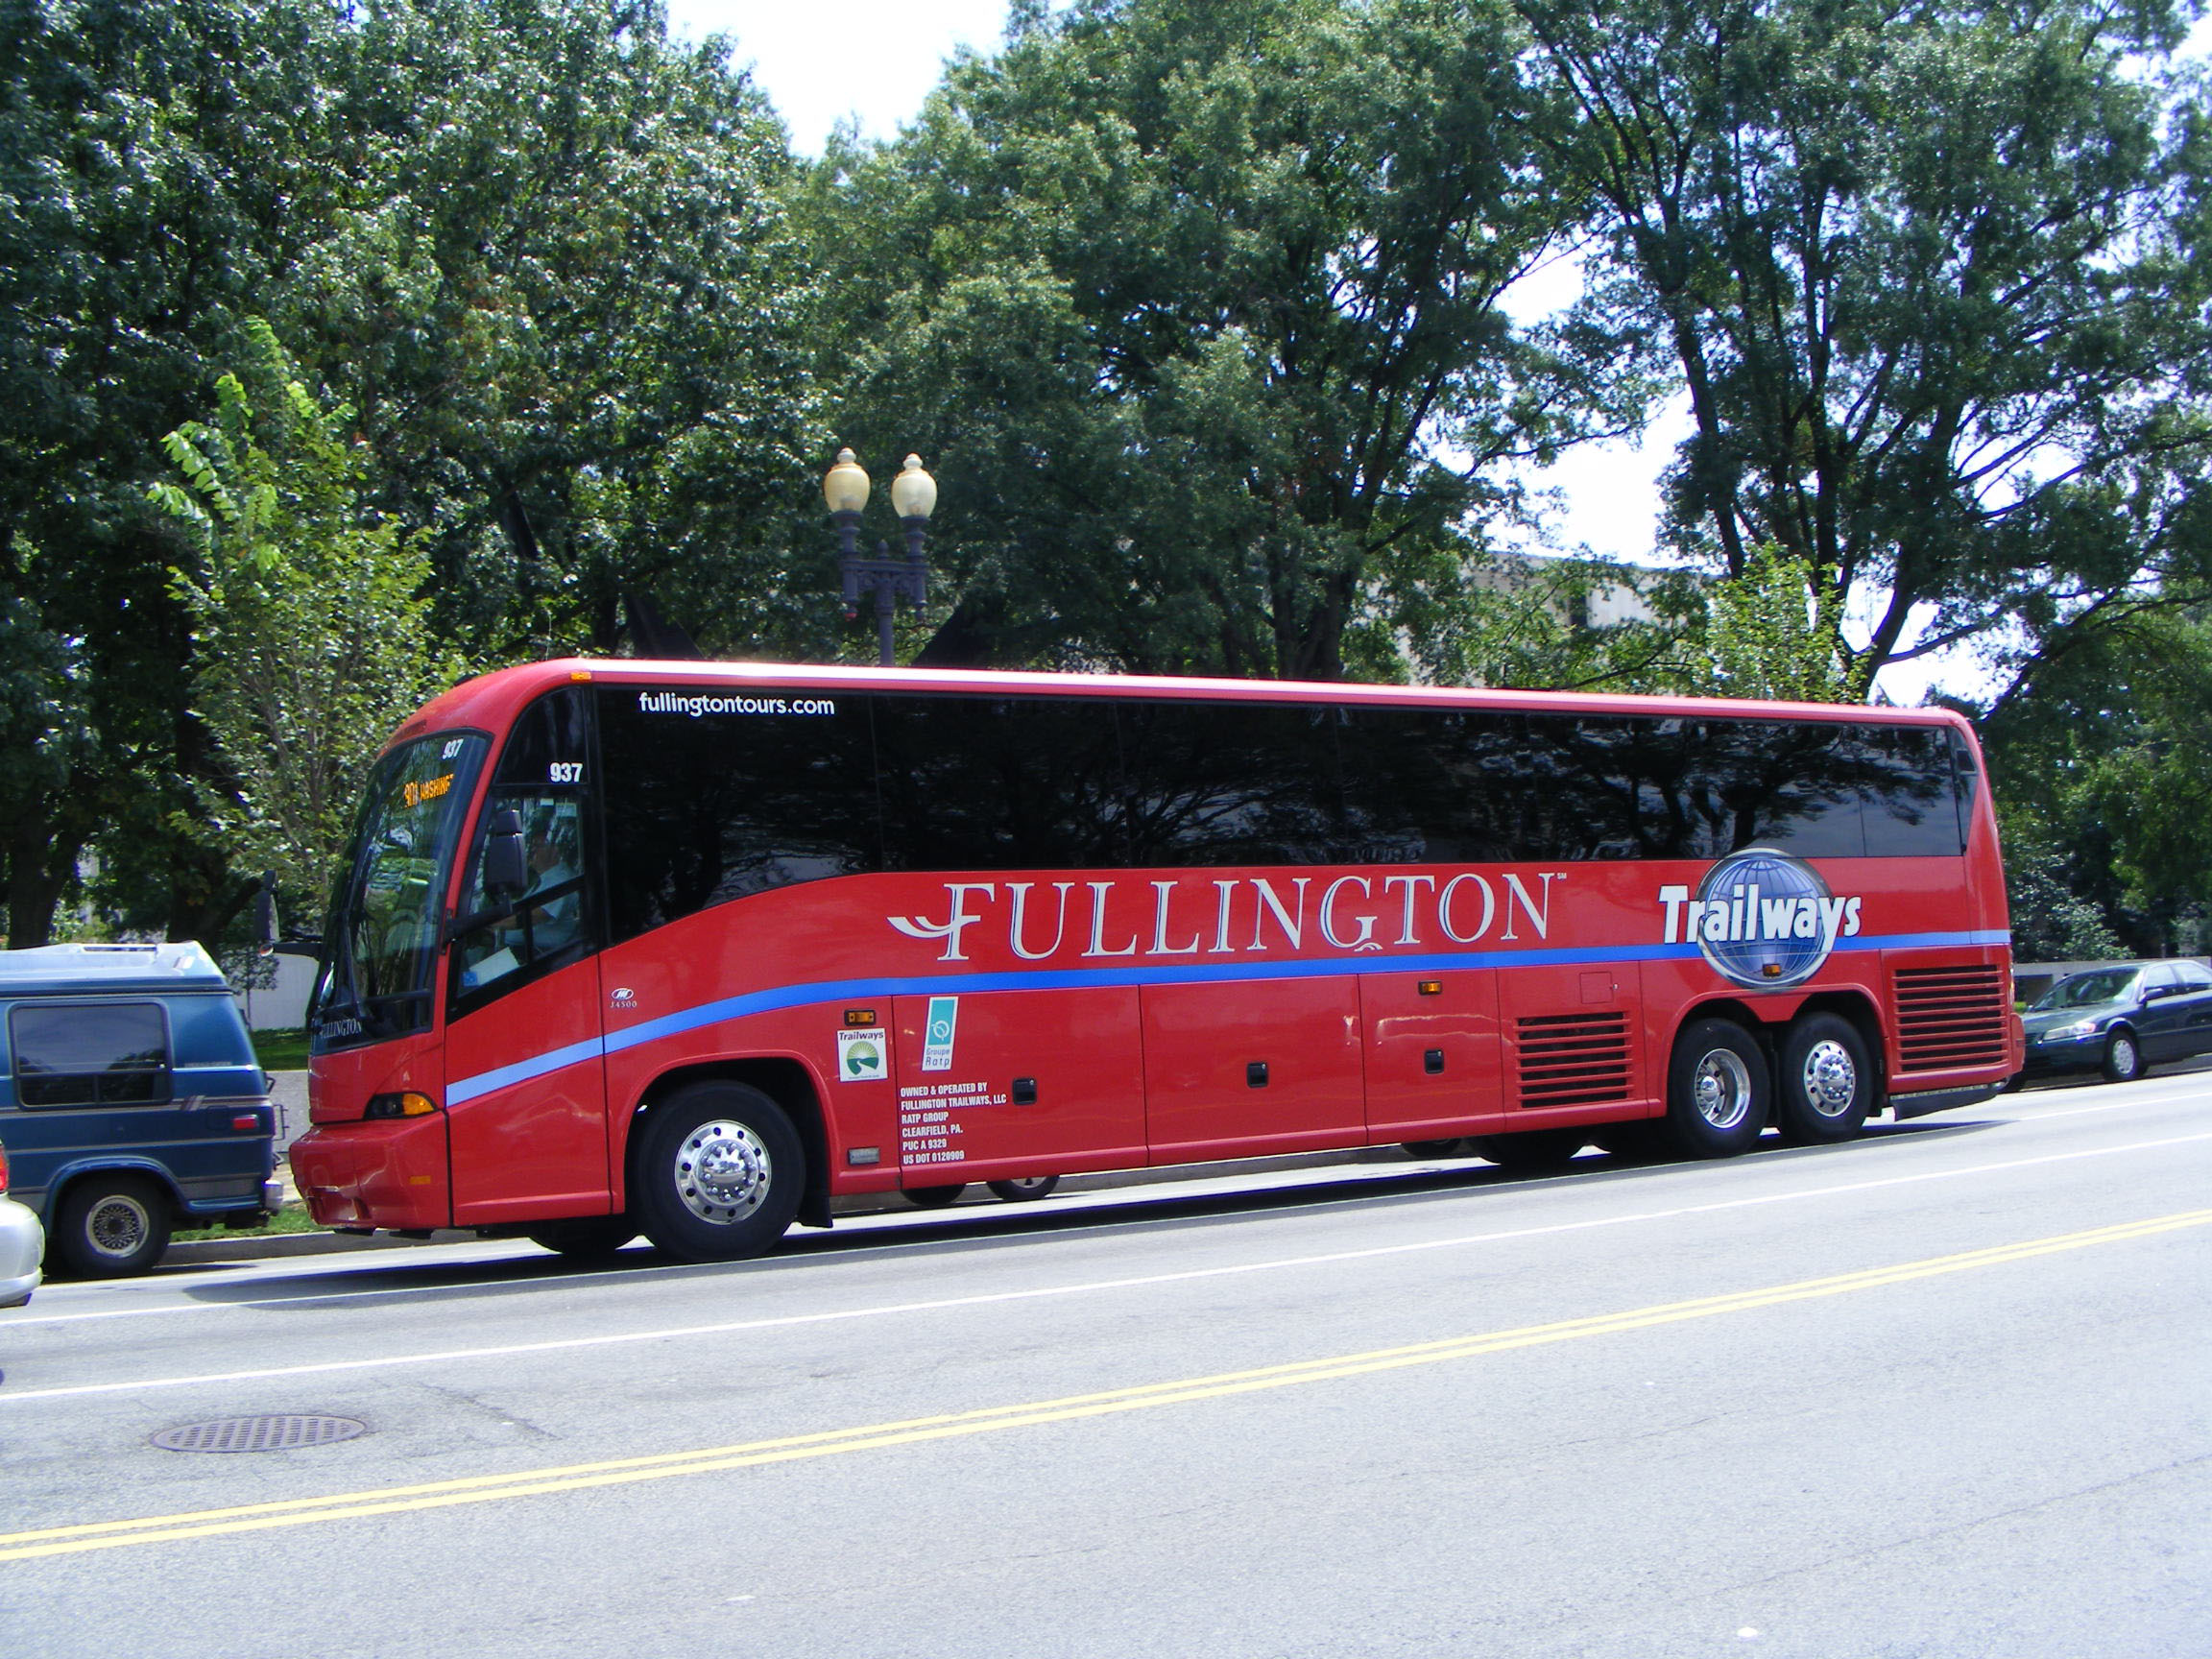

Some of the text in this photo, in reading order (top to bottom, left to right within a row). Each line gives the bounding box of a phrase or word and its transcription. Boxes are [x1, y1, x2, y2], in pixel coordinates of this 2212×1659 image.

[639, 692, 835, 717] fullingtontours.com
[443, 738, 464, 759] 937
[550, 763, 583, 782] 937
[887, 873, 1555, 961] FULLINGTON
[1658, 884, 1862, 953] Trailways
[839, 1031, 884, 1041] Trailways
[926, 1047, 950, 1056] Groupe
[926, 1057, 950, 1068] Ratp
[901, 1082, 988, 1097] OWNED & OPERATED BY
[902, 1094, 1007, 1111] FULLINGTON TRAILWAYS, LLC
[902, 1112, 950, 1124] RATP GROUP
[902, 1123, 964, 1138] CLEARFIELD, PA.
[902, 1141, 919, 1151] PUC
[921, 1140, 926, 1149] A
[903, 1154, 914, 1165] US
[916, 1153, 930, 1164] DOT
